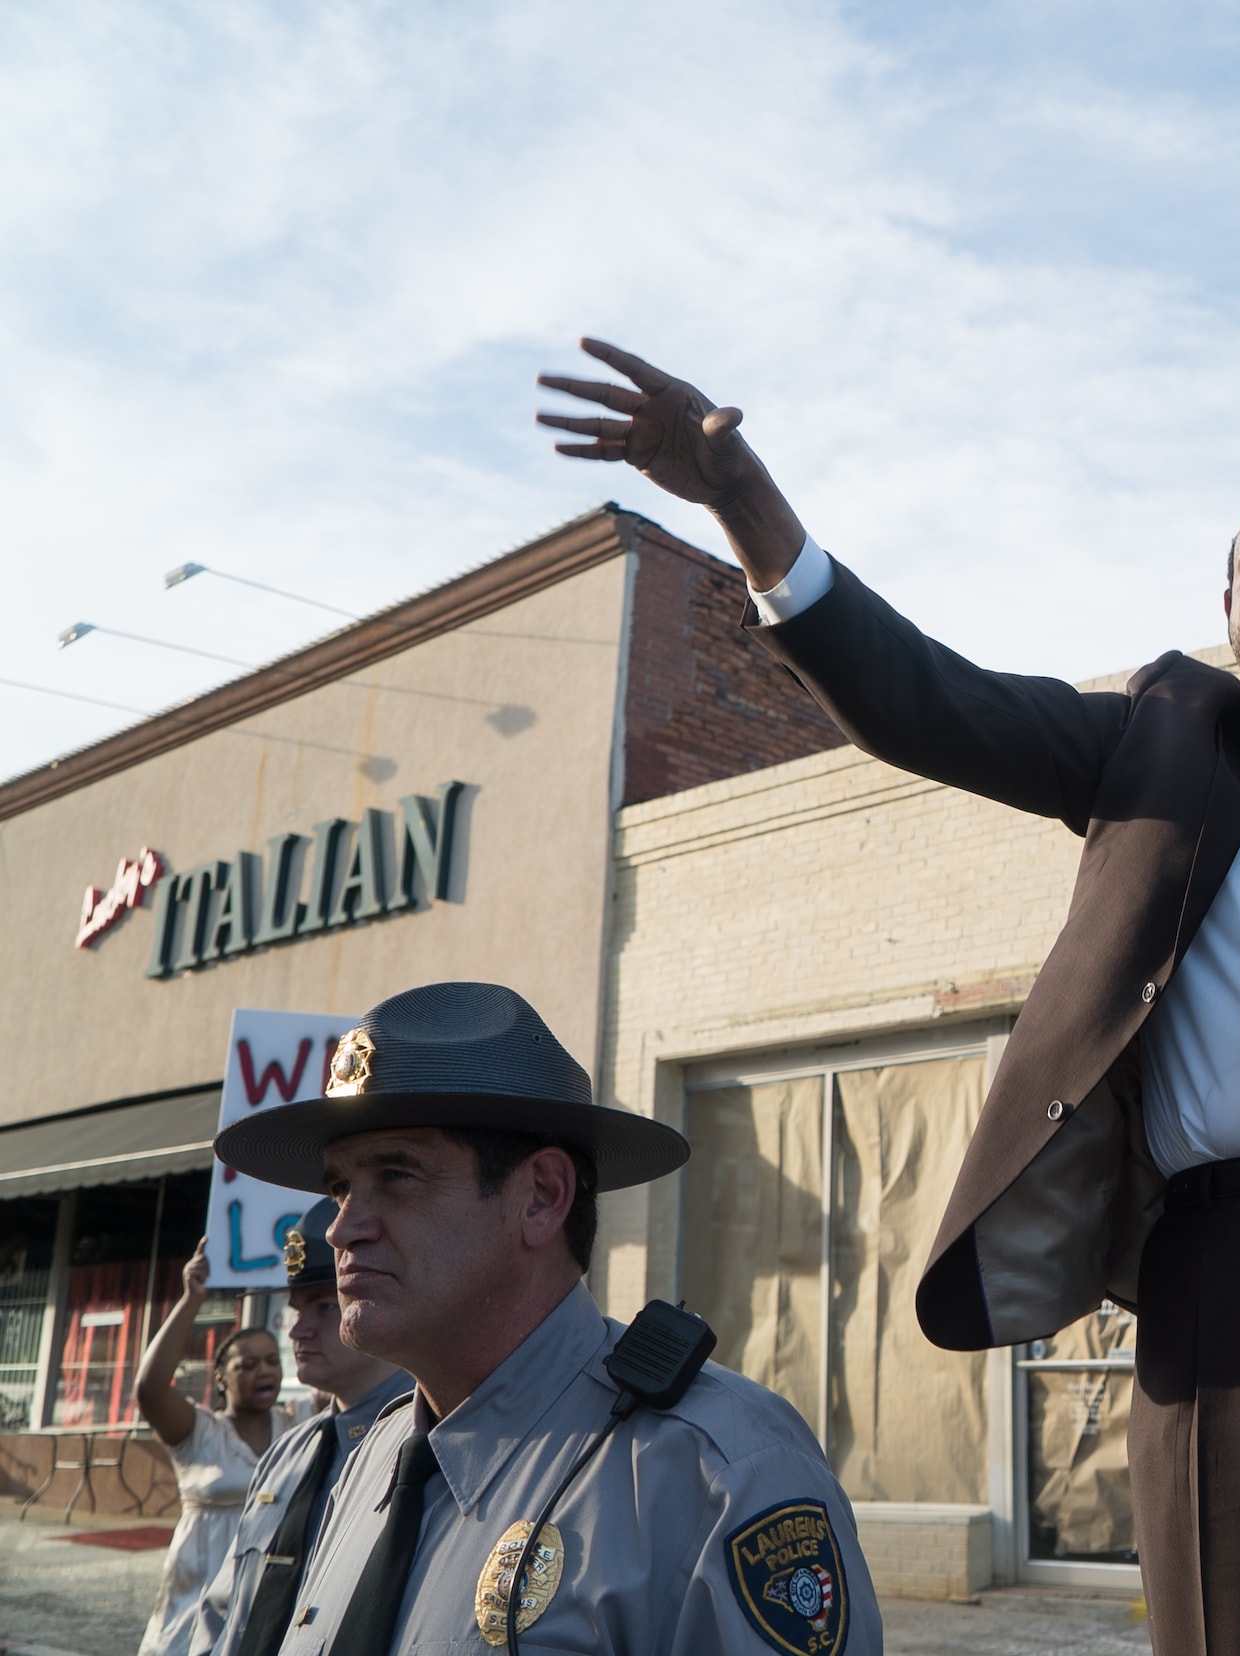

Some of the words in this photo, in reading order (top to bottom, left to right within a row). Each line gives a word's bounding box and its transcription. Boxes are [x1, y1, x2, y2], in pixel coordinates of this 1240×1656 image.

[145, 780, 466, 979] ITALIAN
[500, 1541, 552, 1559] POLCE
[742, 1516, 826, 1566] LAURENS
[499, 1553, 545, 1571] OFFER
[765, 1539, 819, 1571] POLICE
[484, 1593, 533, 1608] LAURS
[808, 1631, 834, 1653] S.C.
